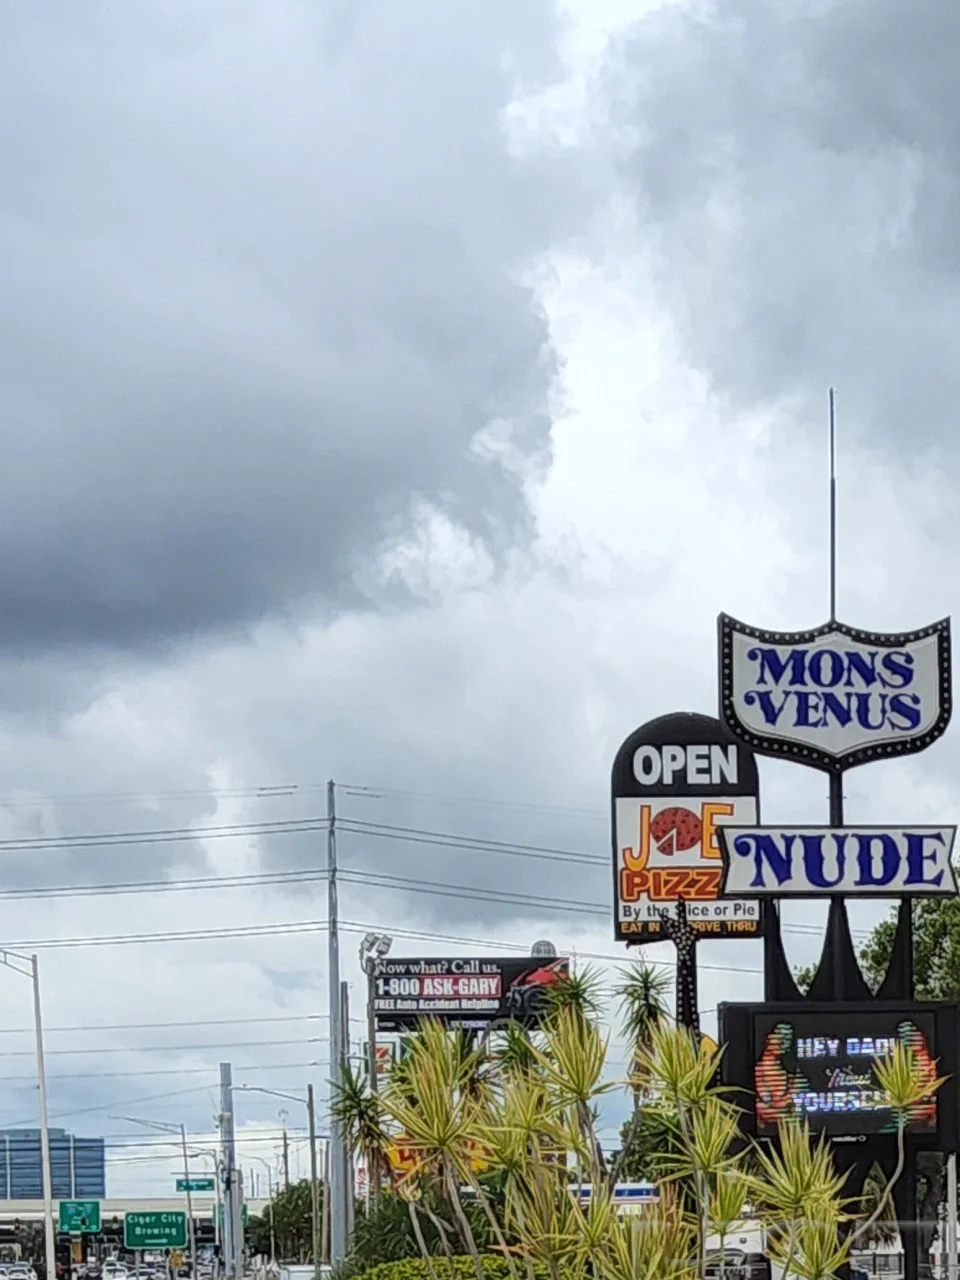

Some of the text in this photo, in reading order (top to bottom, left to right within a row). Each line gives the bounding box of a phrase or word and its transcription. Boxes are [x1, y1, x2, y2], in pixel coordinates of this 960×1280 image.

[747, 648, 914, 688] MONS
[744, 690, 921, 731] VENUS
[633, 744, 738, 785] OPEN
[734, 831, 946, 889] NUDE
[622, 867, 722, 900] PIZZ
[623, 903, 755, 920] By the Sice or Pie
[621, 921, 660, 933] EAT IN
[727, 921, 757, 932] THRU
[376, 960, 501, 975] Now what? Call us.
[376, 977, 499, 996] 1-800 ASK-GARY
[797, 1038, 840, 1057] HEY
[792, 1092, 895, 1112] YOURSEL
[127, 1214, 184, 1227] Cigar City
[135, 1226, 177, 1236] Brewing
